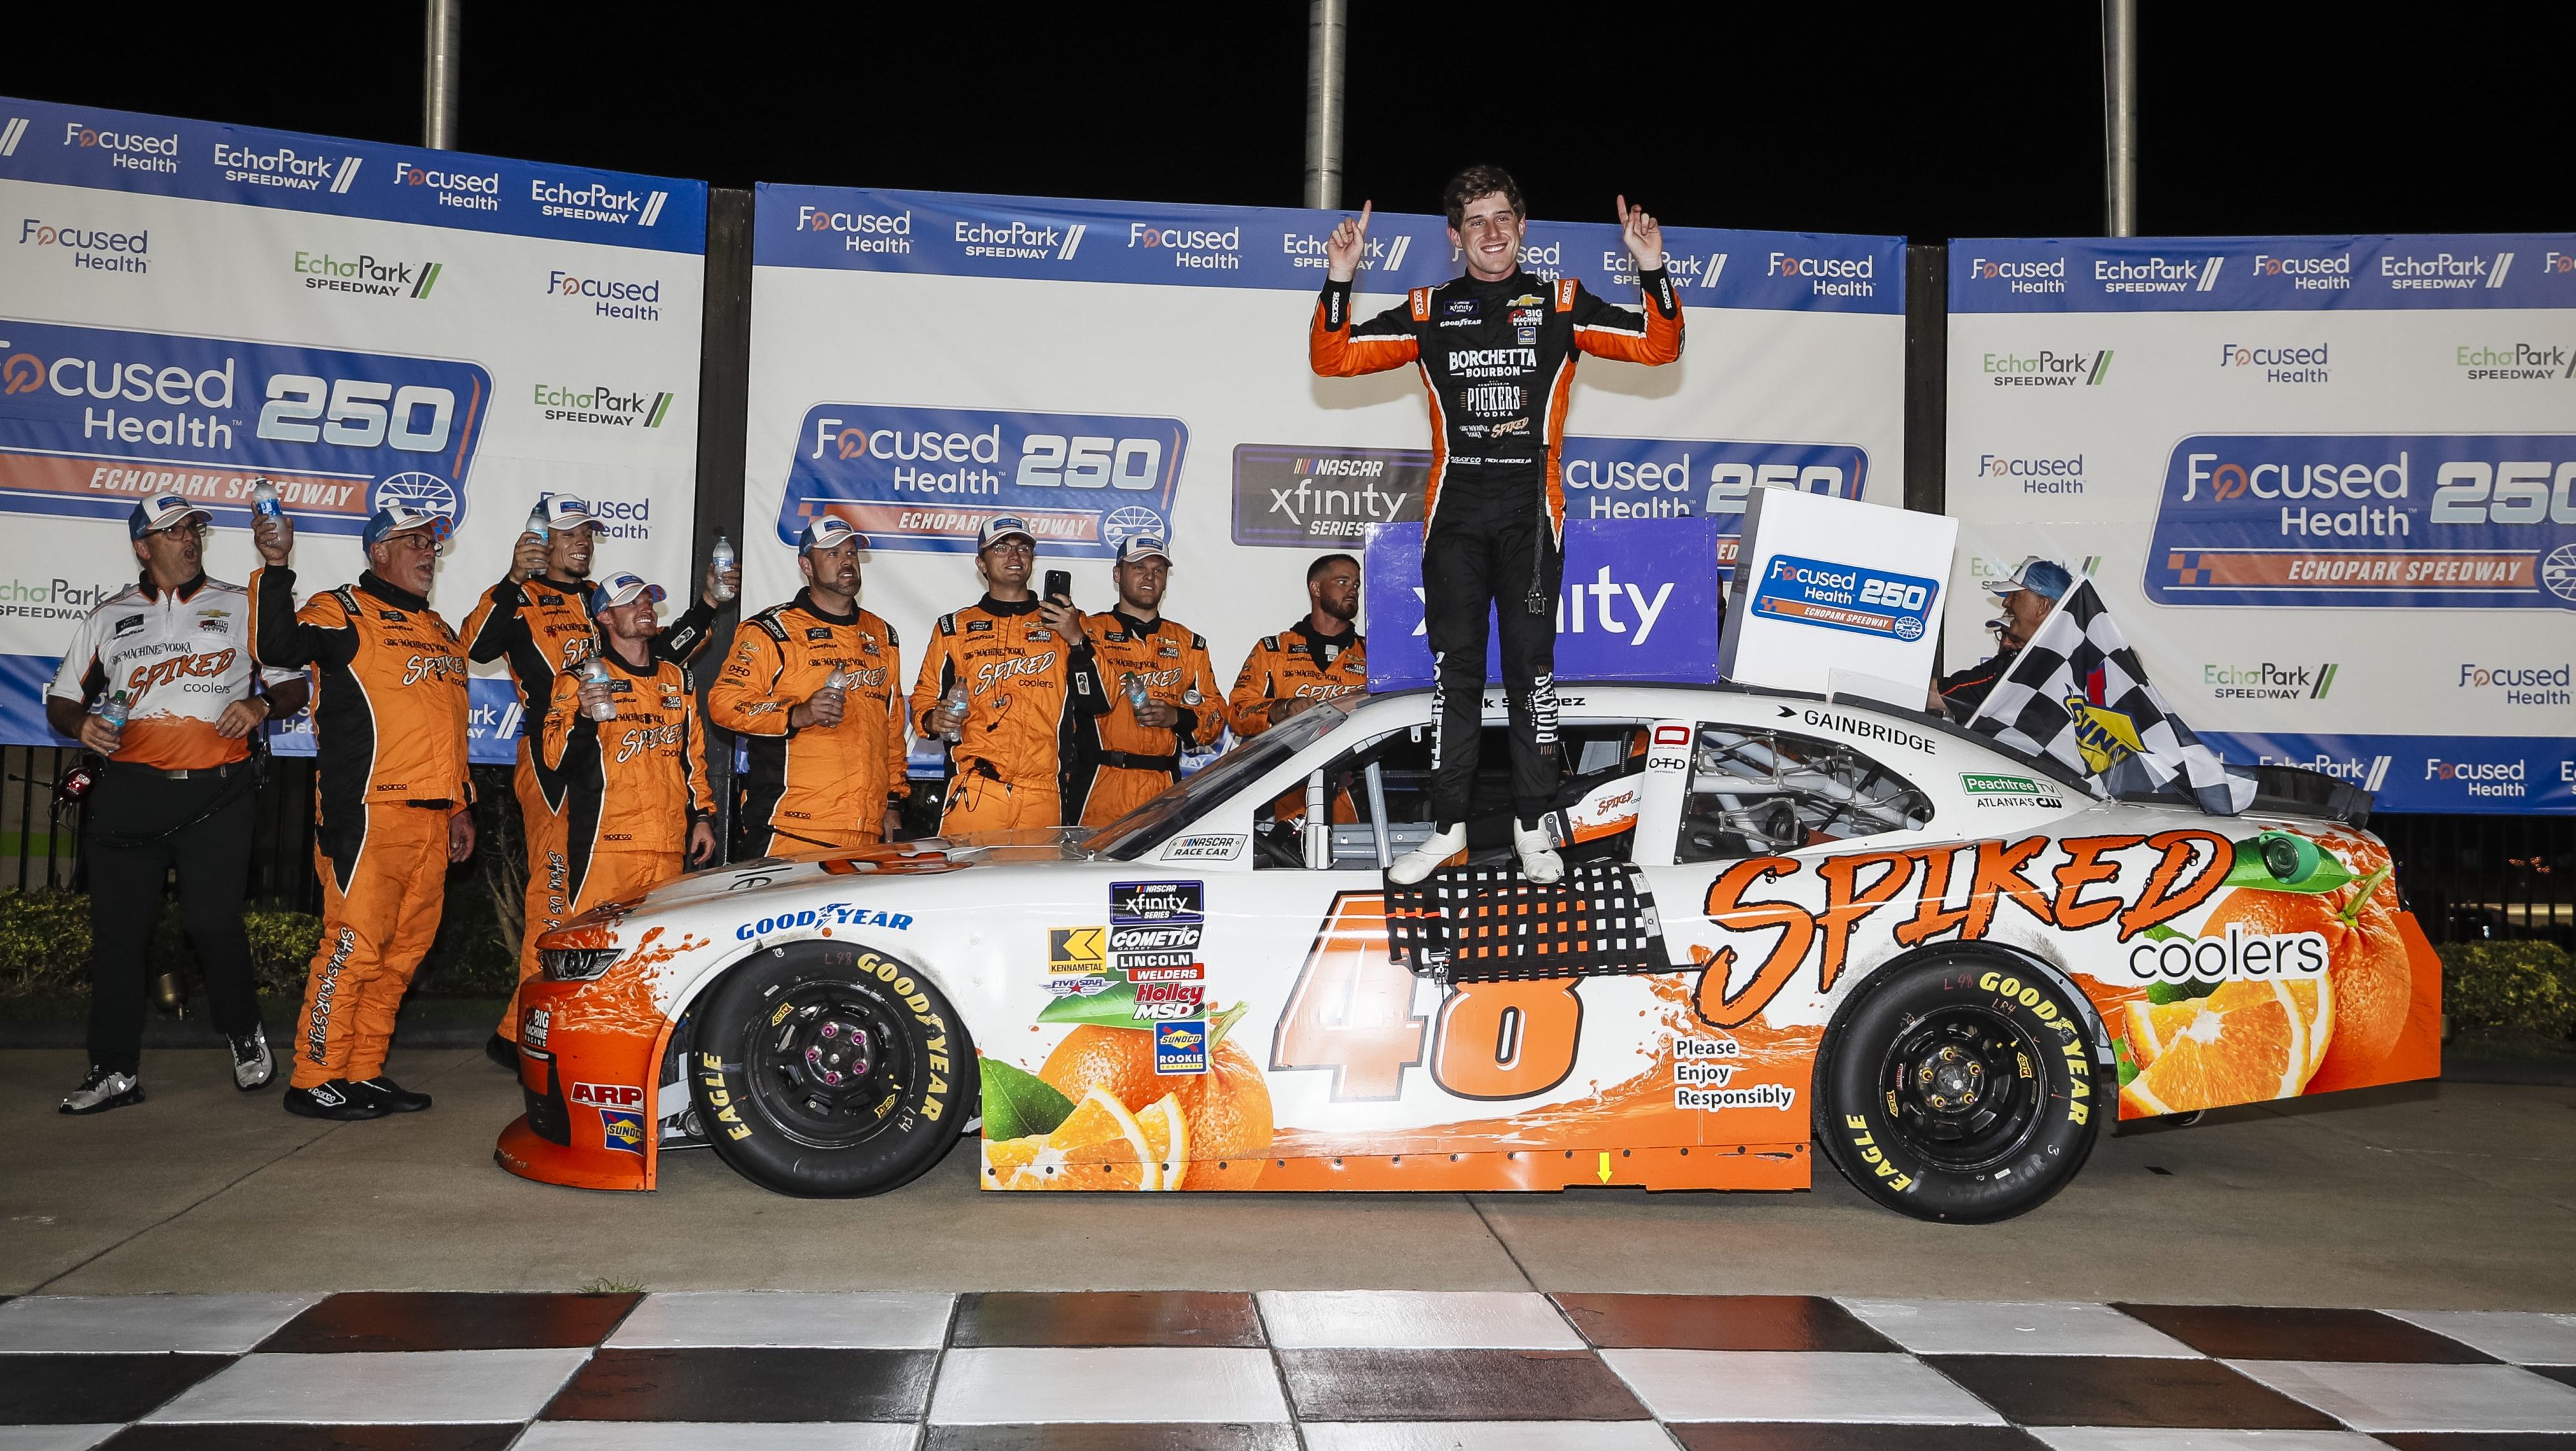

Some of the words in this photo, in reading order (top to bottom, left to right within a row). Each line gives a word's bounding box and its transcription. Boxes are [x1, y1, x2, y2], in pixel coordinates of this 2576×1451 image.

[64, 123, 178, 156] Focused
[113, 153, 177, 173] Health
[214, 144, 332, 178] EchoPark
[225, 170, 319, 191] SPEEDWAY
[394, 162, 498, 194] Focused
[439, 191, 498, 211] Health
[532, 180, 639, 212] EchoPark
[542, 205, 629, 223] SPEEDWAY
[797, 206, 911, 236] Focused
[19, 219, 148, 254] Focused
[956, 221, 1059, 246] EchoPark
[1128, 223, 1239, 251] Focused
[846, 236, 910, 254] Health
[965, 246, 1048, 260] SPEEDWAY
[75, 252, 147, 274] Health
[295, 251, 412, 285] EchoPark
[1177, 251, 1239, 269] Health
[1293, 257, 1375, 270] SPEEAY
[1767, 252, 1873, 279] Focused
[1971, 258, 2064, 280] Focused
[2096, 258, 2197, 280] EchoPark
[2253, 253, 2349, 276] Focused
[2382, 254, 2486, 276] EchoPark
[306, 278, 400, 297] SPEEDWAY
[547, 270, 659, 303] Focused
[1814, 280, 1873, 297] Health
[2011, 280, 2064, 293] Health
[2105, 283, 2188, 292] SPEEDWAY
[2295, 276, 2350, 290] Health
[2392, 279, 2476, 289] SPEEDWAY
[1660, 278, 1672, 310] sparco
[596, 302, 658, 321] Health
[1331, 292, 1340, 323] sparco
[1440, 318, 1482, 327] GOODYEAR
[1449, 348, 1537, 371] BORCHETTA
[1984, 350, 2087, 373] EchoPark
[2221, 343, 2328, 367] Focused
[2457, 343, 2565, 366] EchoPark
[1466, 366, 1520, 378] BOURBON
[1994, 376, 2077, 386] SPEEDWAY
[2268, 369, 2328, 383] Health
[2467, 369, 2554, 380] SPEEDWAY
[535, 384, 645, 413] EchoPark
[1467, 386, 1520, 412] PICKERS
[258, 374, 455, 453] 250
[545, 410, 634, 426] SPEEDWAY
[84, 407, 232, 450] Health
[1491, 417, 1530, 438] SPIKED
[812, 419, 999, 464] Focused
[1016, 434, 1161, 491] 250
[1315, 459, 1383, 477] NASCAR
[1450, 456, 1481, 465] sparco
[1978, 454, 2083, 477] Focused
[90, 467, 221, 498] ECHOPARK
[895, 466, 999, 495] Health
[2024, 480, 2083, 493] Health
[2183, 451, 2408, 502] Focused
[1270, 479, 1406, 526] xfinity
[1309, 520, 1365, 536] SERIES
[2282, 505, 2409, 536] Health
[1771, 560, 1856, 591] Focused
[2287, 561, 2399, 581] ECHOPARK
[2405, 561, 2522, 582] SPEEDWAY
[1804, 587, 1853, 605] Health
[1859, 578, 1927, 611] 250
[1804, 607, 1846, 621] ECHOPARK
[1846, 614, 1889, 629] SPEEDWAY
[121, 645, 161, 660] MACHINE
[161, 642, 193, 654] VODKA
[129, 649, 236, 708] SPIKED
[974, 650, 1056, 696] SPIKED
[1019, 678, 1054, 688] coolers
[2204, 663, 2310, 687] EchoPark
[2459, 663, 2570, 687] Focused
[184, 682, 231, 694] coolers
[2215, 688, 2300, 699] SPEEDWAY
[2508, 690, 2570, 706] Health
[1804, 710, 1936, 755] GAINBRIDGE
[2425, 759, 2524, 780] Focused
[1967, 778, 2035, 792] Peachtree
[2036, 782, 2055, 793] TV
[2468, 782, 2524, 797] Health
[1597, 790, 1634, 816] SPIKED
[1977, 797, 2035, 808] ATLANTA'S
[2036, 797, 2063, 809] CW
[1173, 848, 1203, 857] RACE
[1206, 848, 1229, 856] CAR
[1193, 837, 1234, 847] NASCAR
[1145, 885, 1177, 893] NASCAR
[1126, 894, 1188, 914] xfinity
[736, 903, 913, 941] GOODYEAR
[1144, 911, 1170, 919] SERIES
[1112, 927, 1199, 948] COMETIC
[1694, 830, 2235, 1029] SPIKED
[1120, 954, 1189, 967] LINCOLN
[2129, 929, 2323, 978] coolers
[1051, 963, 1103, 972] KENNAMETAL
[1137, 969, 1198, 980] WELDERS
[1052, 980, 1075, 988] FIVE
[1136, 983, 1205, 1005] Holley
[1270, 889, 1584, 1102] 48
[534, 1009, 549, 1028] BIG
[775, 1005, 790, 1021] AERO
[1133, 1003, 1195, 1019] MSD
[525, 1023, 547, 1040] MACHINE
[857, 952, 950, 1123] GOODYEAR
[1162, 1034, 1200, 1043] SUNOCO
[1676, 1039, 1736, 1056] Please
[1979, 971, 2090, 1126] GOODYEAR
[1159, 1054, 1203, 1063] ROOKIE
[2020, 1056, 2031, 1077] AERO
[1678, 1064, 1729, 1085] Enjoy
[572, 1083, 643, 1105] ARP
[705, 1051, 752, 1141] EAGLE
[1678, 1087, 1792, 1108] Responsibly
[1888, 1094, 1897, 1113] AERO
[1846, 1113, 1913, 1192] EAGLE
